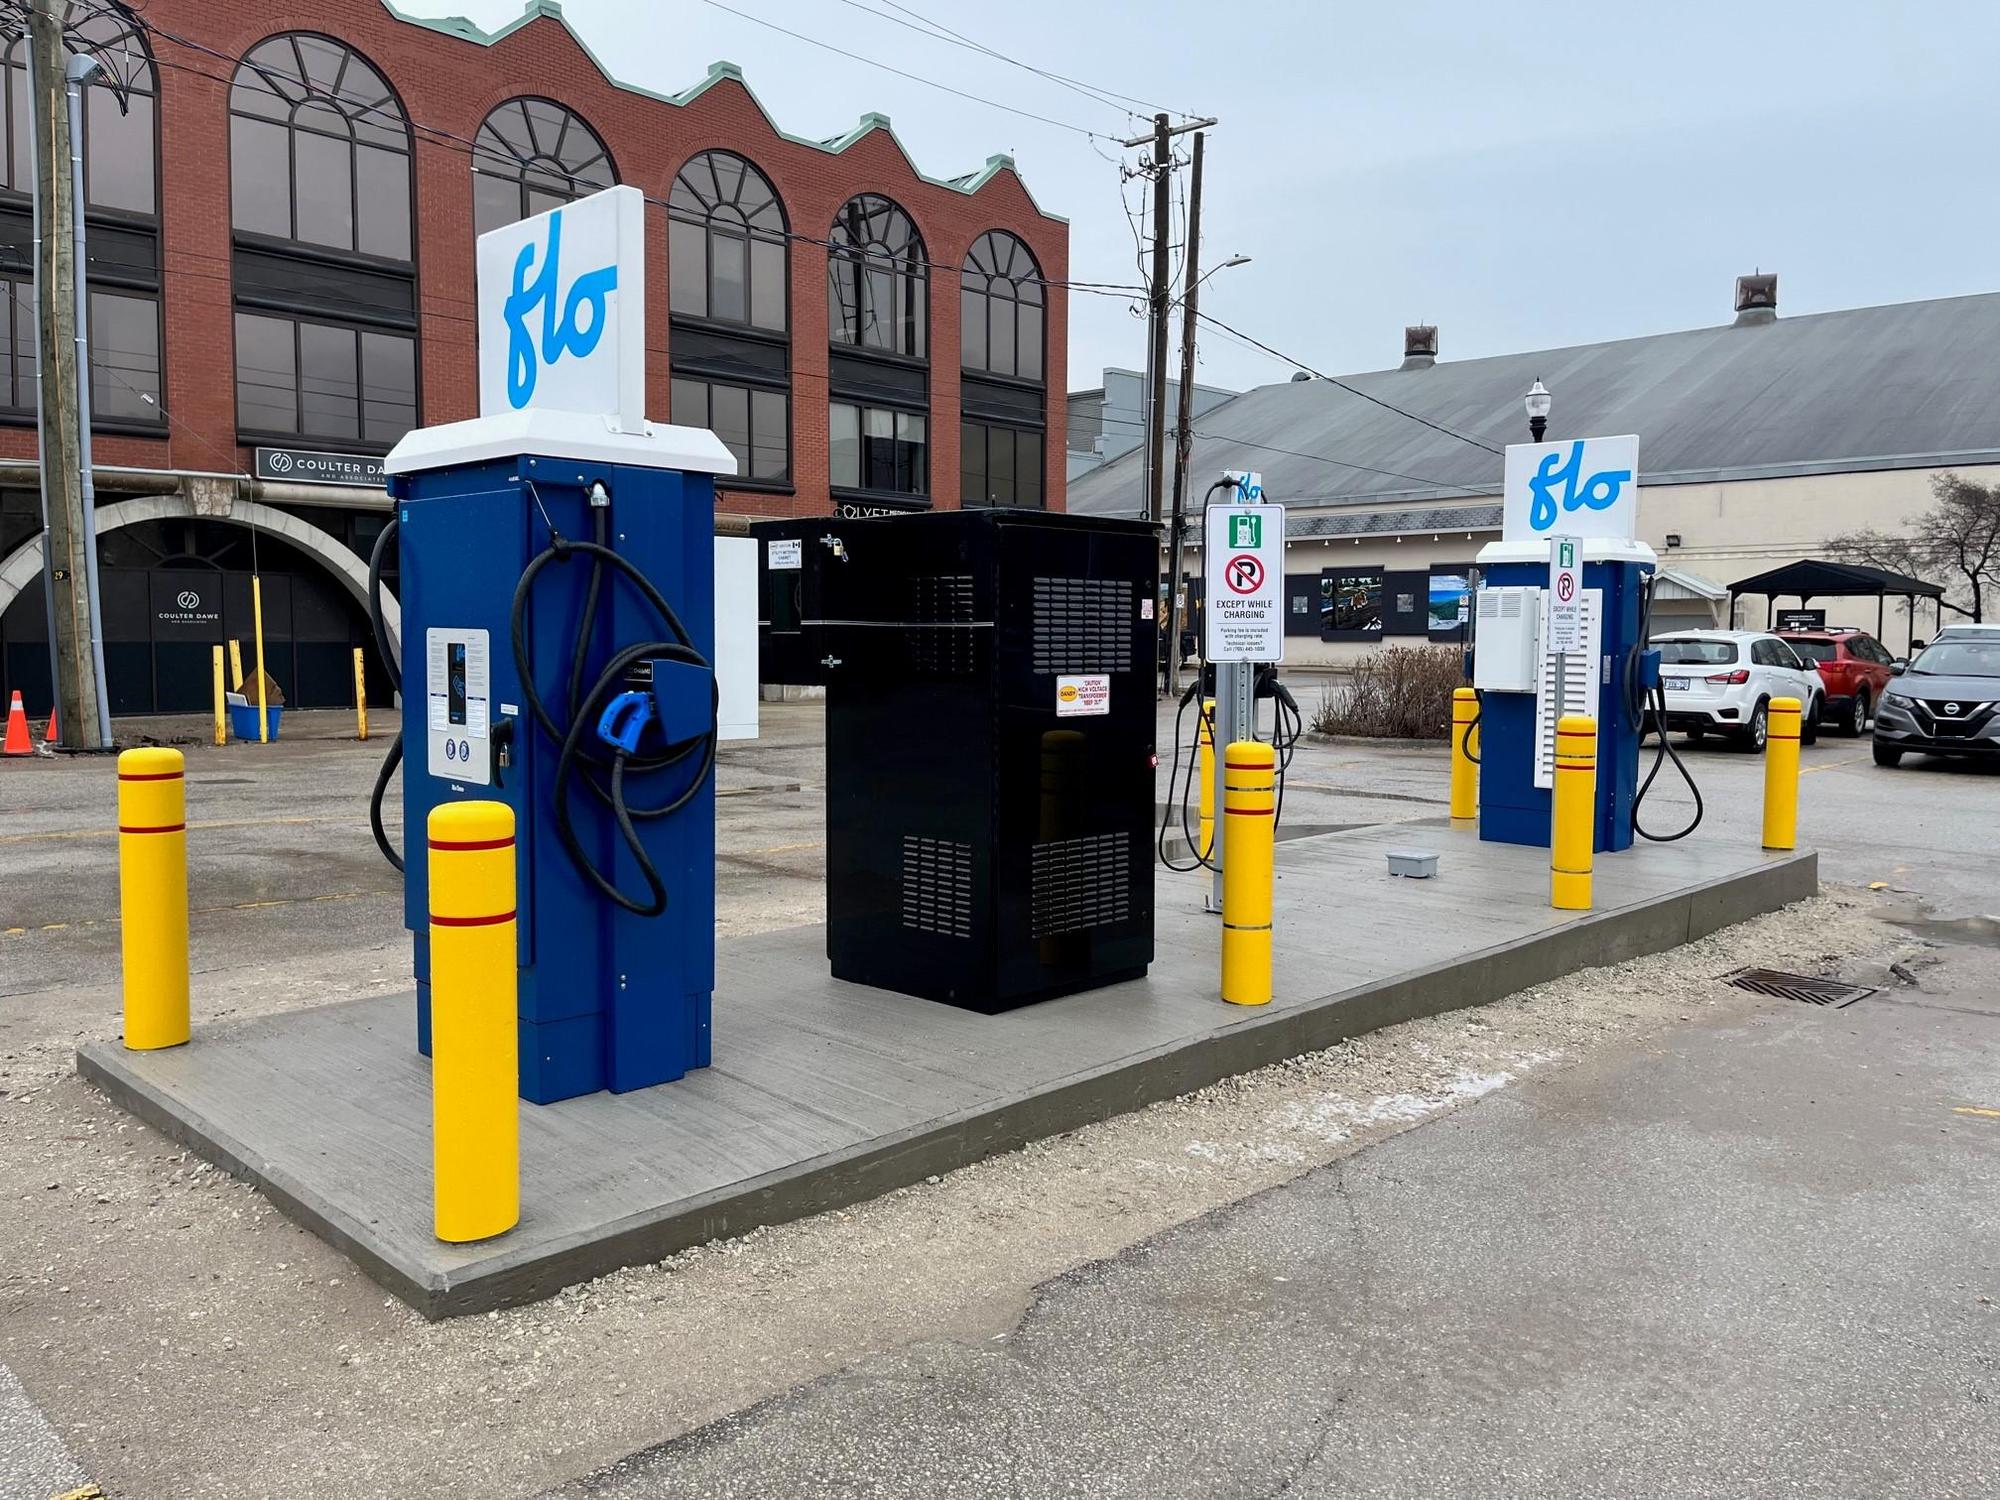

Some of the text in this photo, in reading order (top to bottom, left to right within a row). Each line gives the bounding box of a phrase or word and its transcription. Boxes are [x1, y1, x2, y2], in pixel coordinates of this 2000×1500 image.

[504, 209, 617, 409] flo
[297, 459, 385, 474] COULTER DA
[1529, 441, 1631, 530] flo
[1216, 600, 1273, 608] EXCEPT WHILE
[1224, 611, 1265, 619] CHARGING
